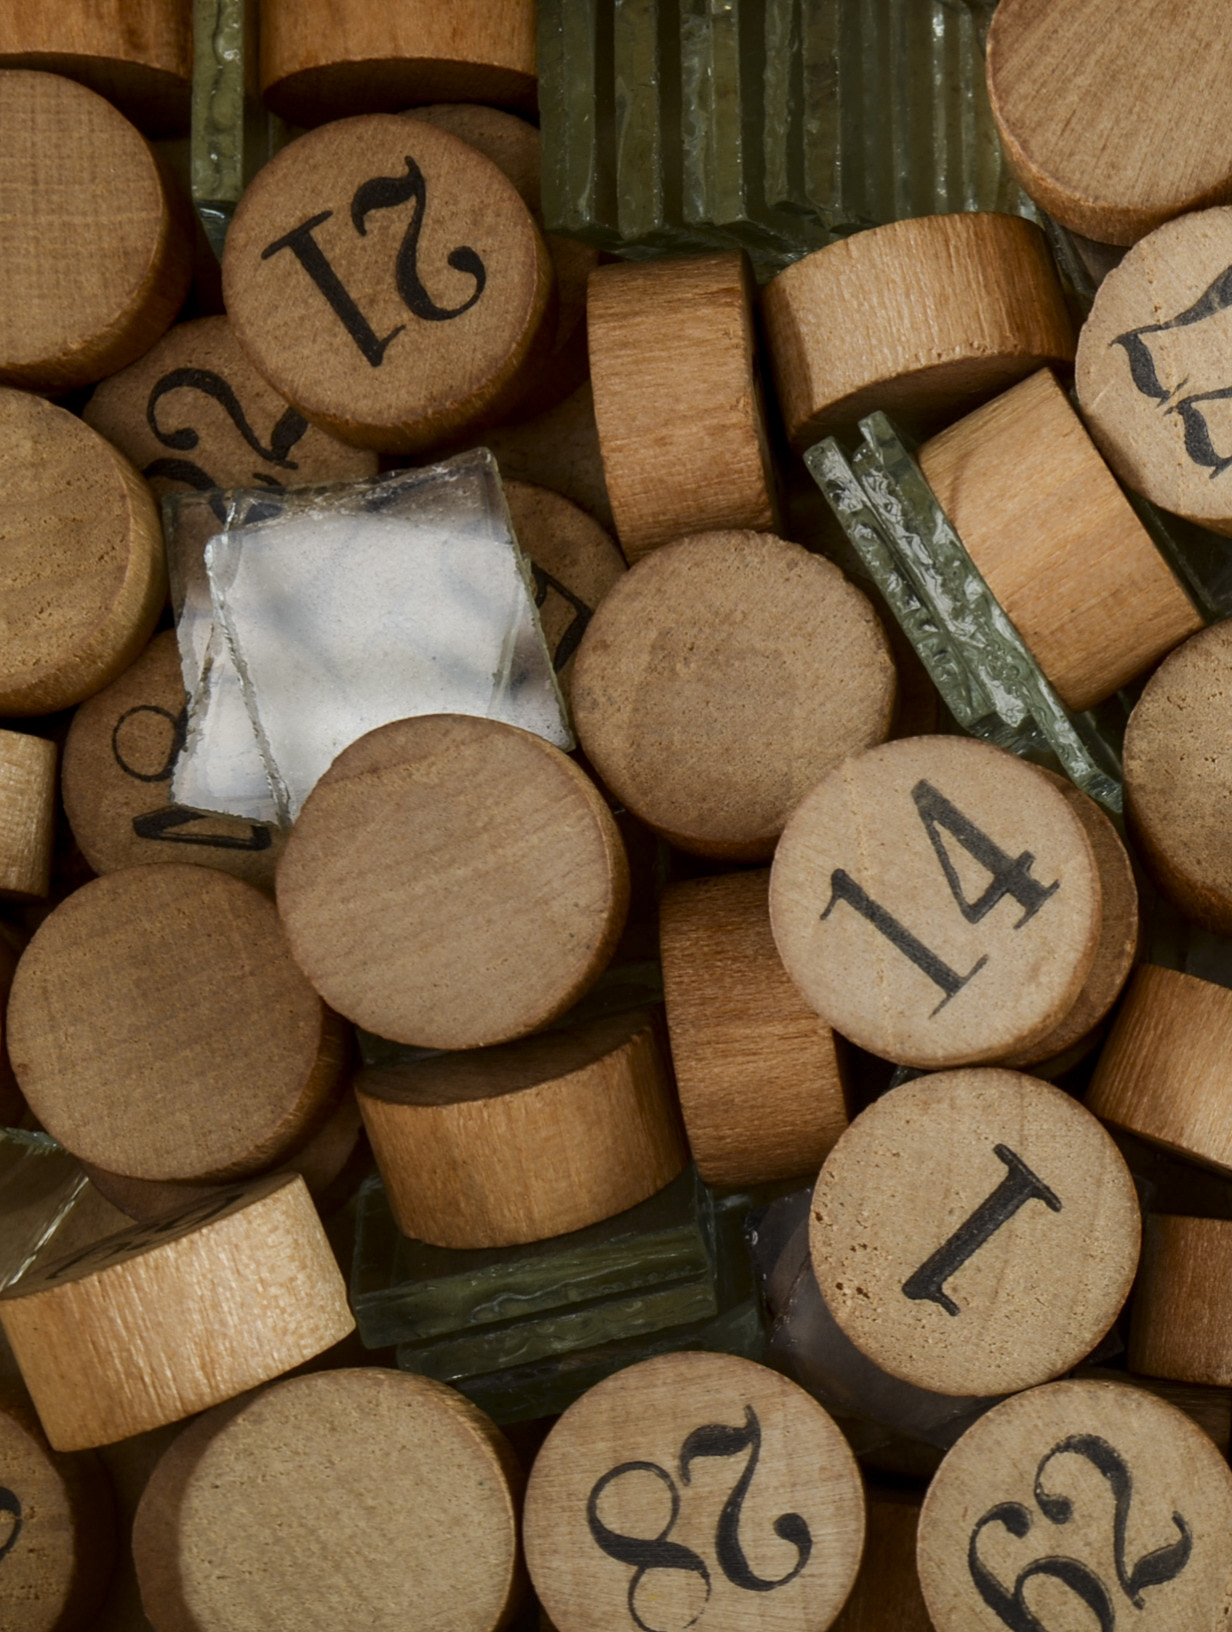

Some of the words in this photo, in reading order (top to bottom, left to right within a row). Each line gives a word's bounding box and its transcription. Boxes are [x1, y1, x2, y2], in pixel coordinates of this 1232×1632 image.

[261, 156, 487, 367] 21
[820, 779, 1060, 1016] 14
[901, 1144, 1062, 1316] 1
[586, 1405, 813, 1632] 28
[967, 1434, 1192, 1632] 62
